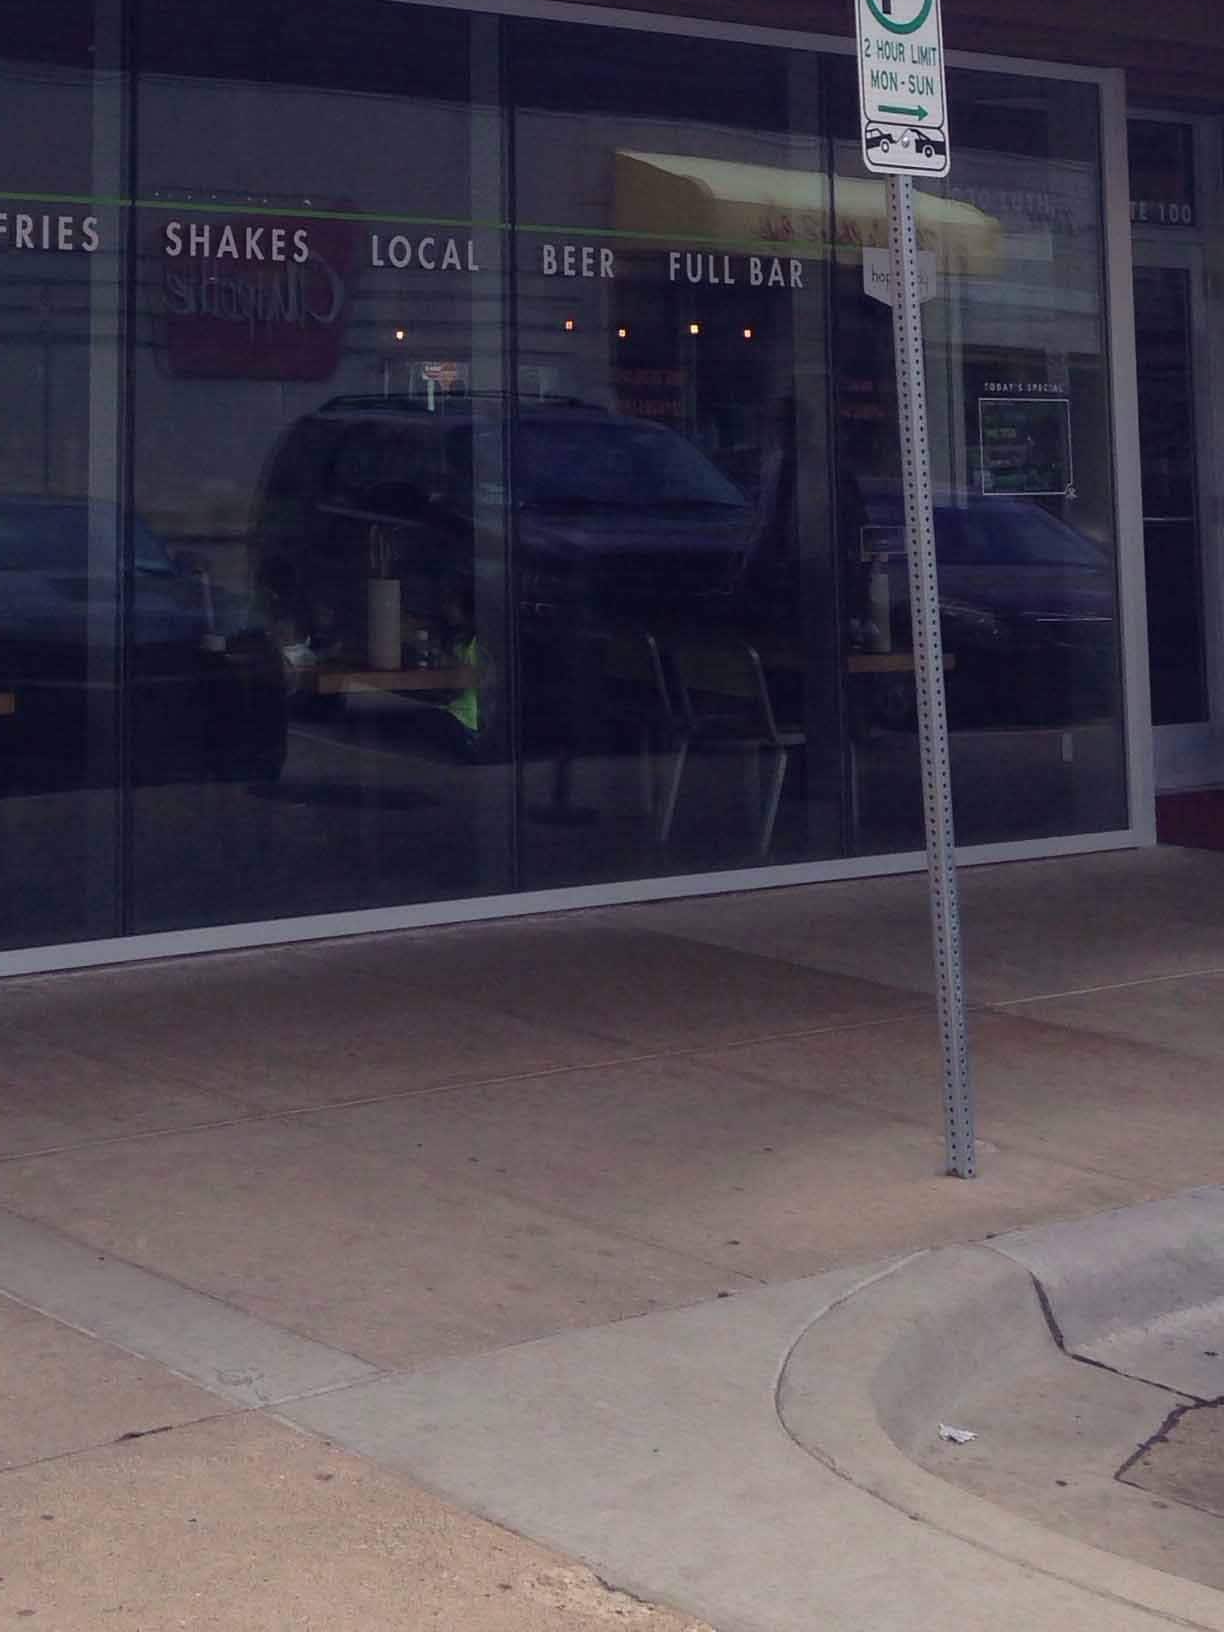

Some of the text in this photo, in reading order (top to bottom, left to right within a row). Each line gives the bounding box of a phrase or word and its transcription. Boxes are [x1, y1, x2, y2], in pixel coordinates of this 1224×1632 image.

[864, 37, 937, 67] 2 HOUR LIMIT
[1159, 202, 1192, 224] 100
[165, 221, 309, 263] SHAKES
[371, 234, 480, 271] LOCAL
[542, 243, 616, 279] BEER
[668, 251, 736, 286] FULL
[749, 256, 804, 289] BAR
